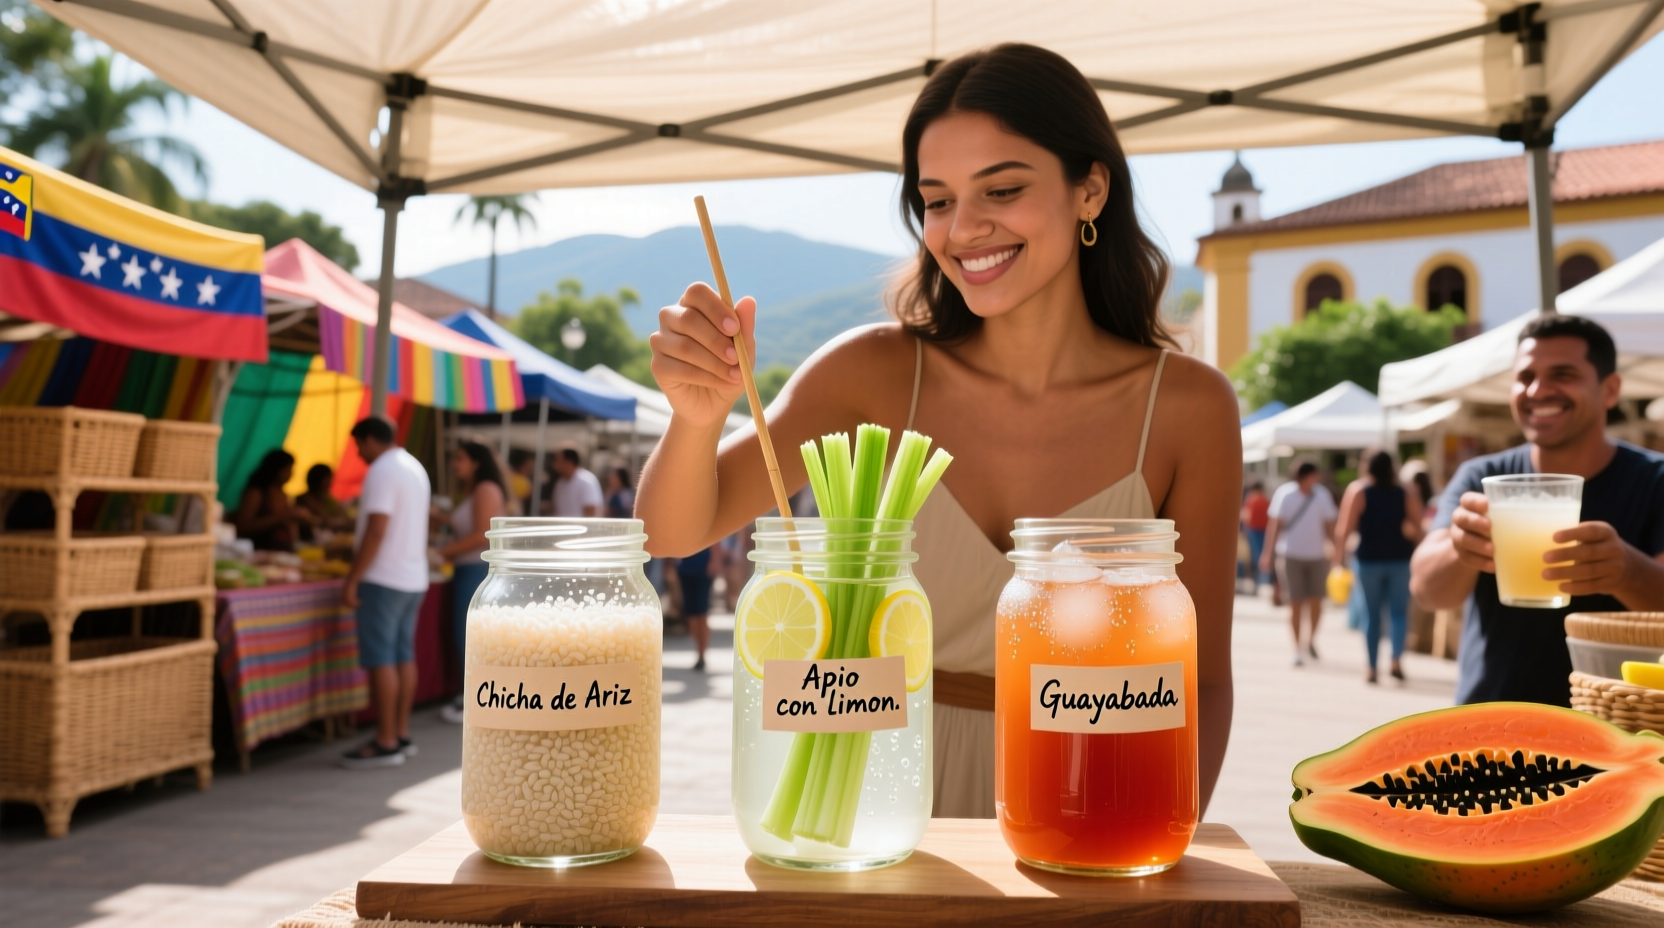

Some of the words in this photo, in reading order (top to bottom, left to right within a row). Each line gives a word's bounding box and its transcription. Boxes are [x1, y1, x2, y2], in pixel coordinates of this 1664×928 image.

[476, 680, 544, 710] Chicha
[550, 682, 577, 711] de
[584, 679, 633, 709] Ariz
[801, 663, 860, 699] Apio
[776, 698, 818, 717] con
[1039, 676, 1179, 725] Guayabada
